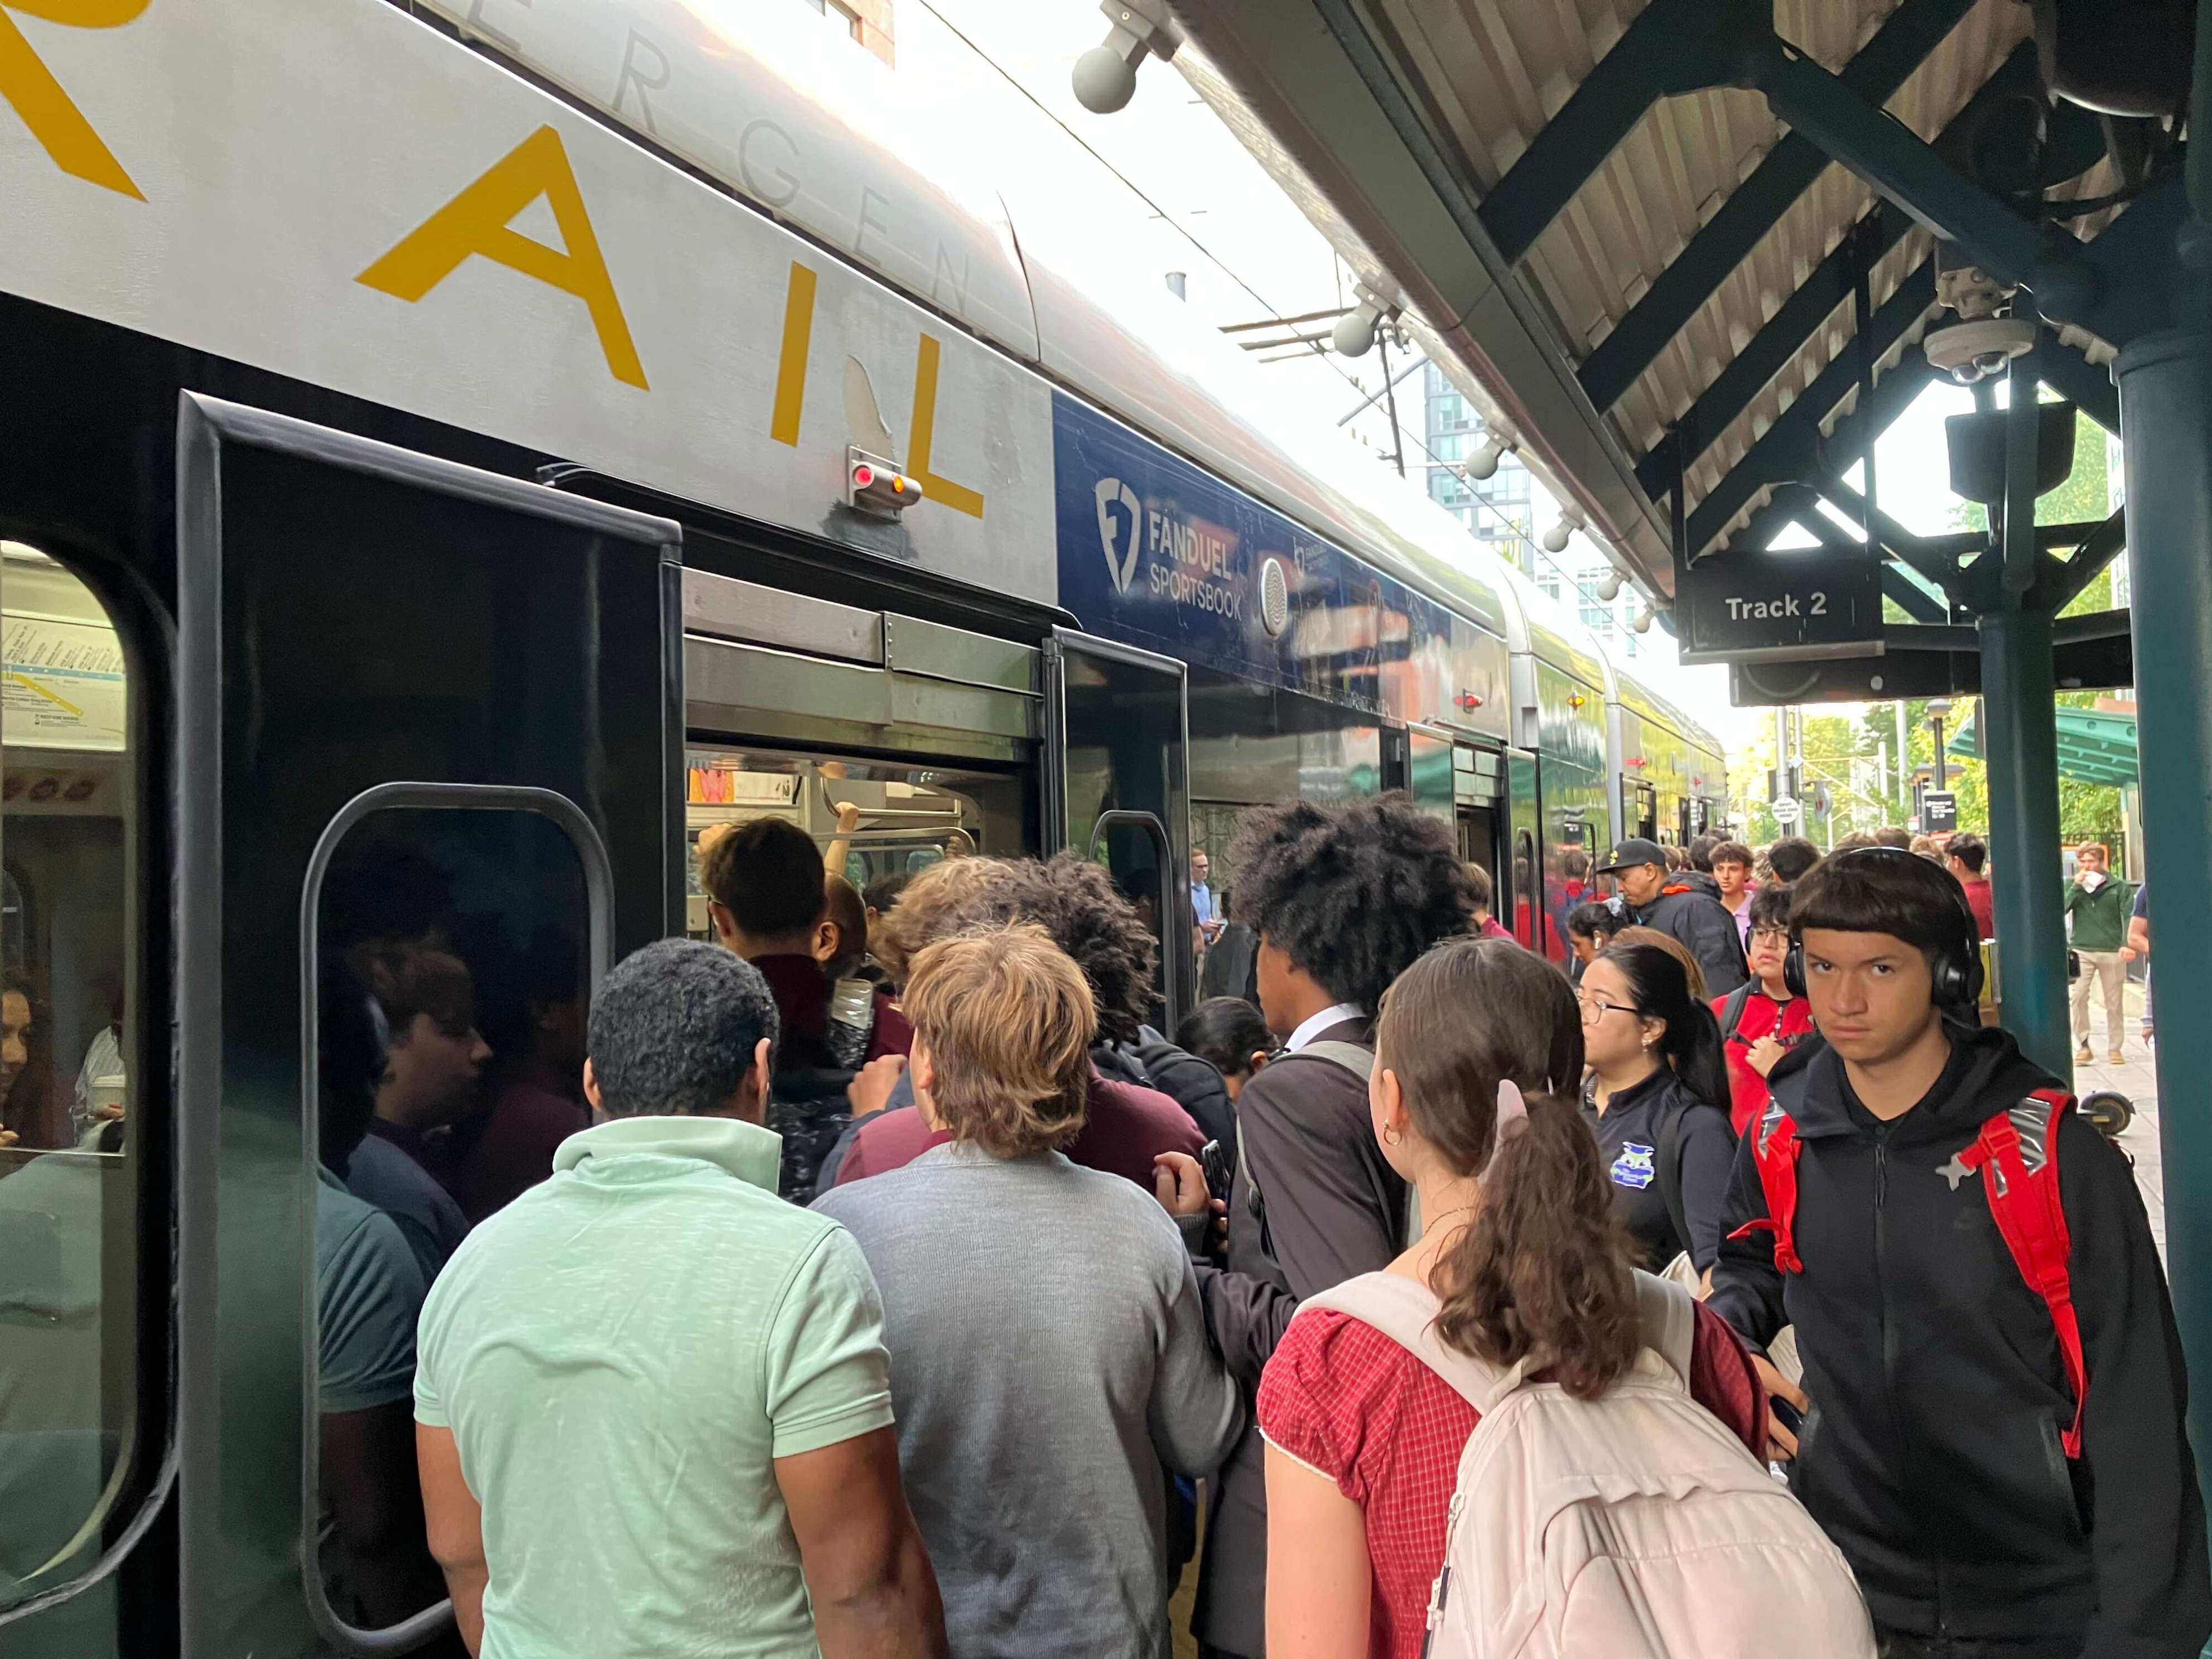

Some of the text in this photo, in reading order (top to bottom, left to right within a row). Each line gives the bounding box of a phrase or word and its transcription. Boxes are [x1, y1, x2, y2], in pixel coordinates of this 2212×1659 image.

[1149, 510, 1232, 581] FANDUEL
[1150, 562, 1242, 621] SPORTSBOOK
[1725, 591, 1827, 620] Track 2
